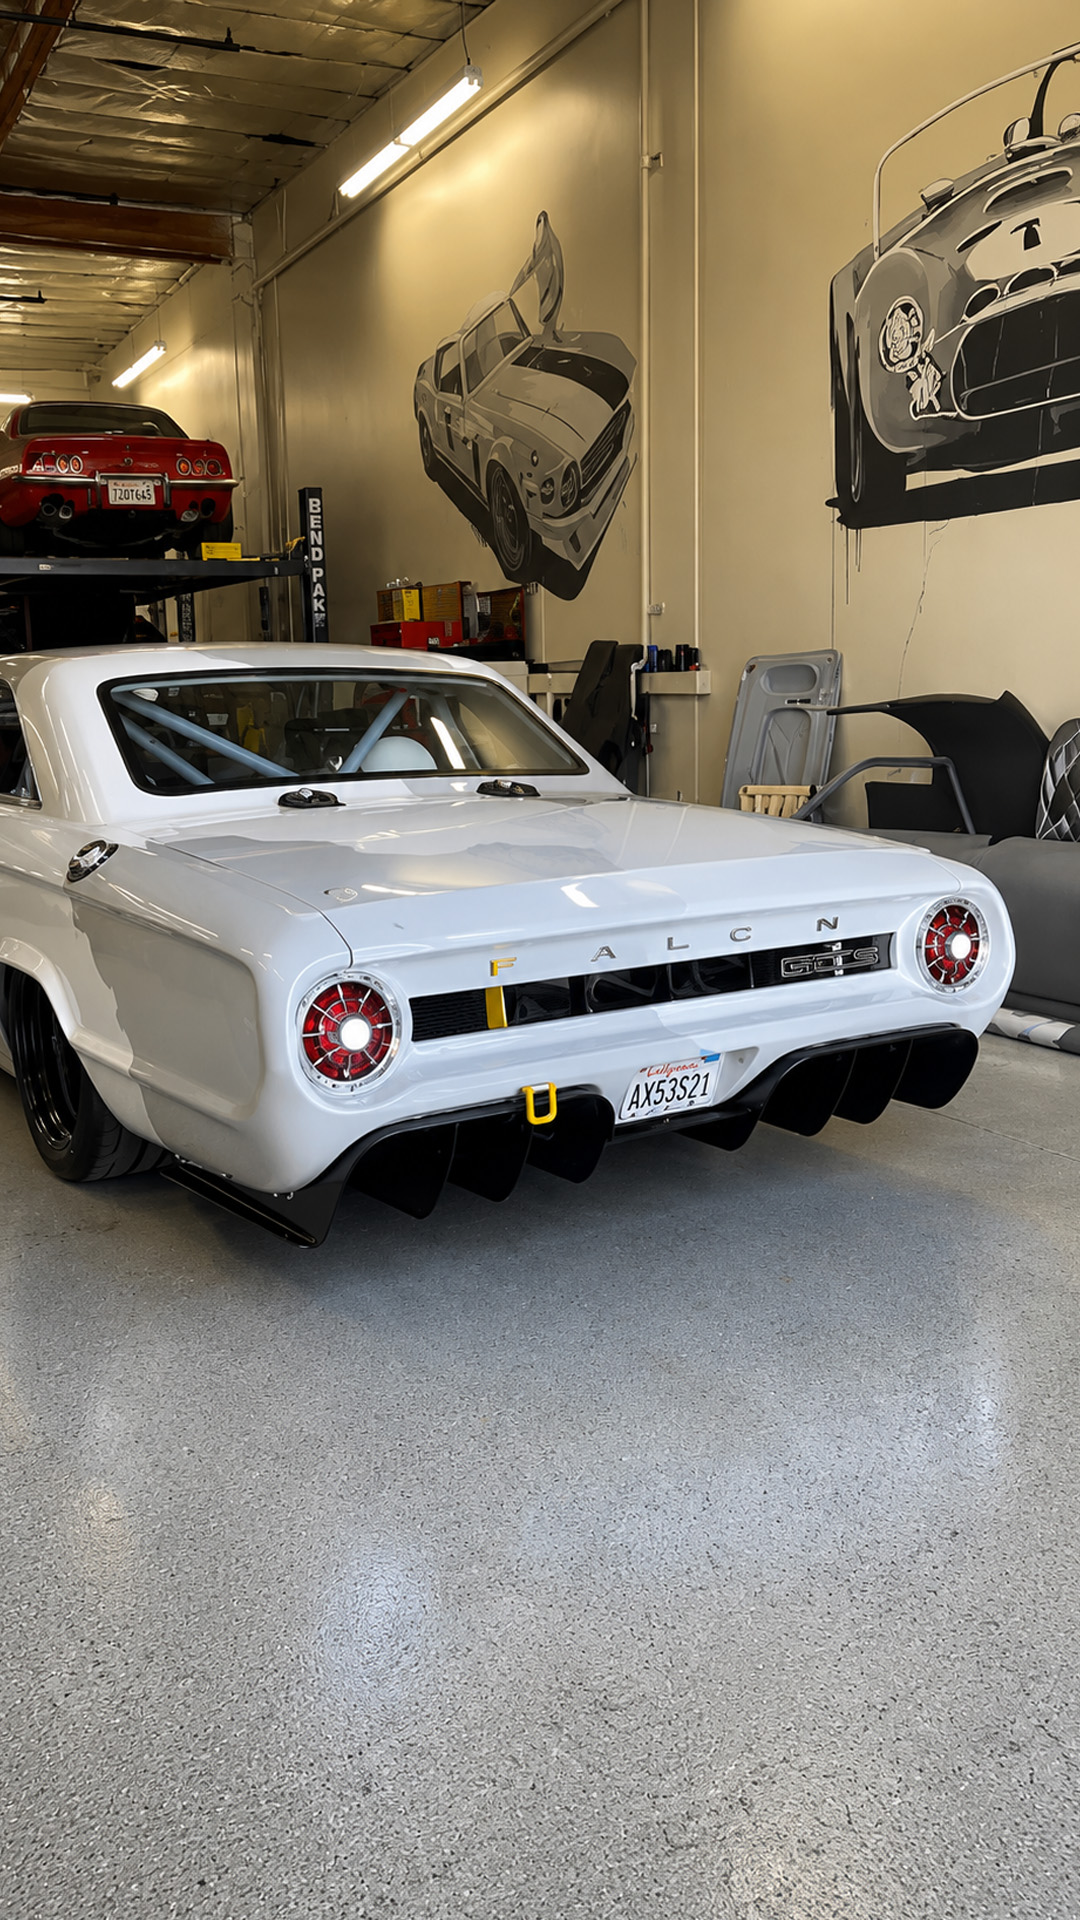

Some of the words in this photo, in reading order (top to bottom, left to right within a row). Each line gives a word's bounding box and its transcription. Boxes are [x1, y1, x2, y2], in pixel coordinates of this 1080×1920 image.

[308, 498, 324, 561] BEND
[312, 567, 326, 612] PAK
[627, 1072, 710, 1111] AX53S21
